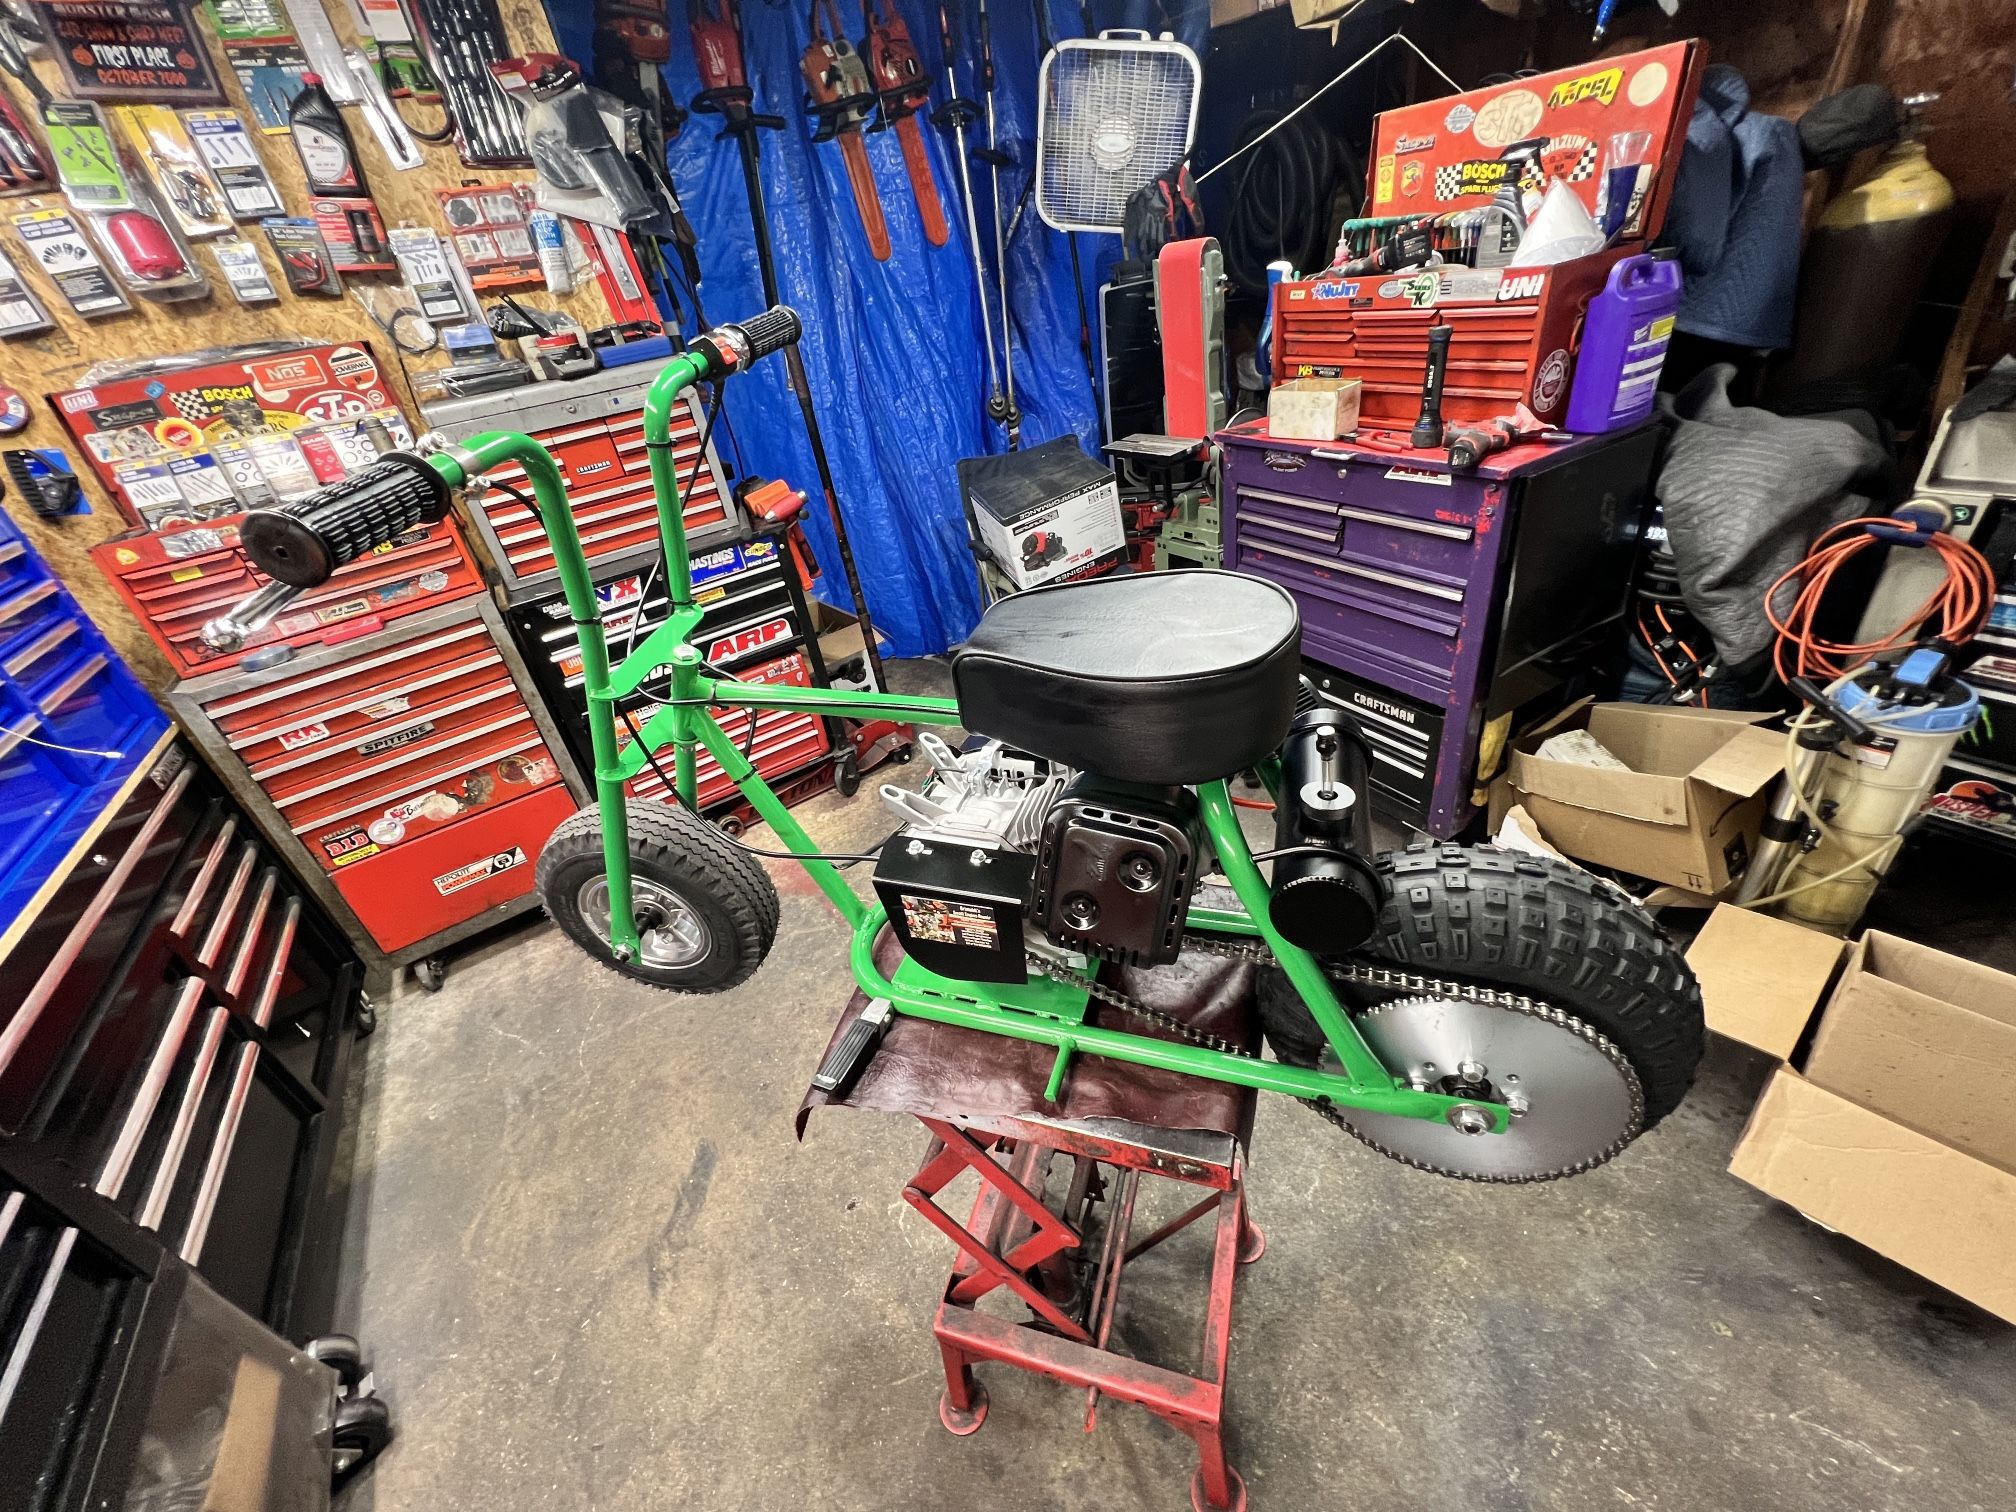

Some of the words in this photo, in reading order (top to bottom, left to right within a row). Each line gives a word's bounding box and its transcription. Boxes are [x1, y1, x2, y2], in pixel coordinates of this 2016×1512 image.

[91, 44, 131, 68] FIRST
[130, 46, 175, 68] PLACE
[97, 68, 158, 85] OCTOBER
[1463, 162, 1507, 181] BOSCH
[1461, 184, 1481, 194] SPARK
[1498, 273, 1545, 301] UNI
[1414, 291, 1426, 306] K
[265, 362, 306, 381] NOS
[1298, 364, 1313, 377] KB
[65, 392, 95, 409] UNI
[202, 385, 254, 403] BOSCH
[304, 393, 366, 421] STP
[576, 460, 611, 474] CRAFTSMAN
[1082, 481, 1101, 493] MAX
[1019, 489, 1081, 520] PERFORMANCE
[689, 547, 735, 572] HASTINGS
[1054, 561, 1095, 583] ENGINES
[604, 614, 633, 629] ARP
[709, 618, 788, 663] ARP
[1353, 691, 1416, 724] CRAFTSMAN
[364, 725, 427, 752] SPITFIRE
